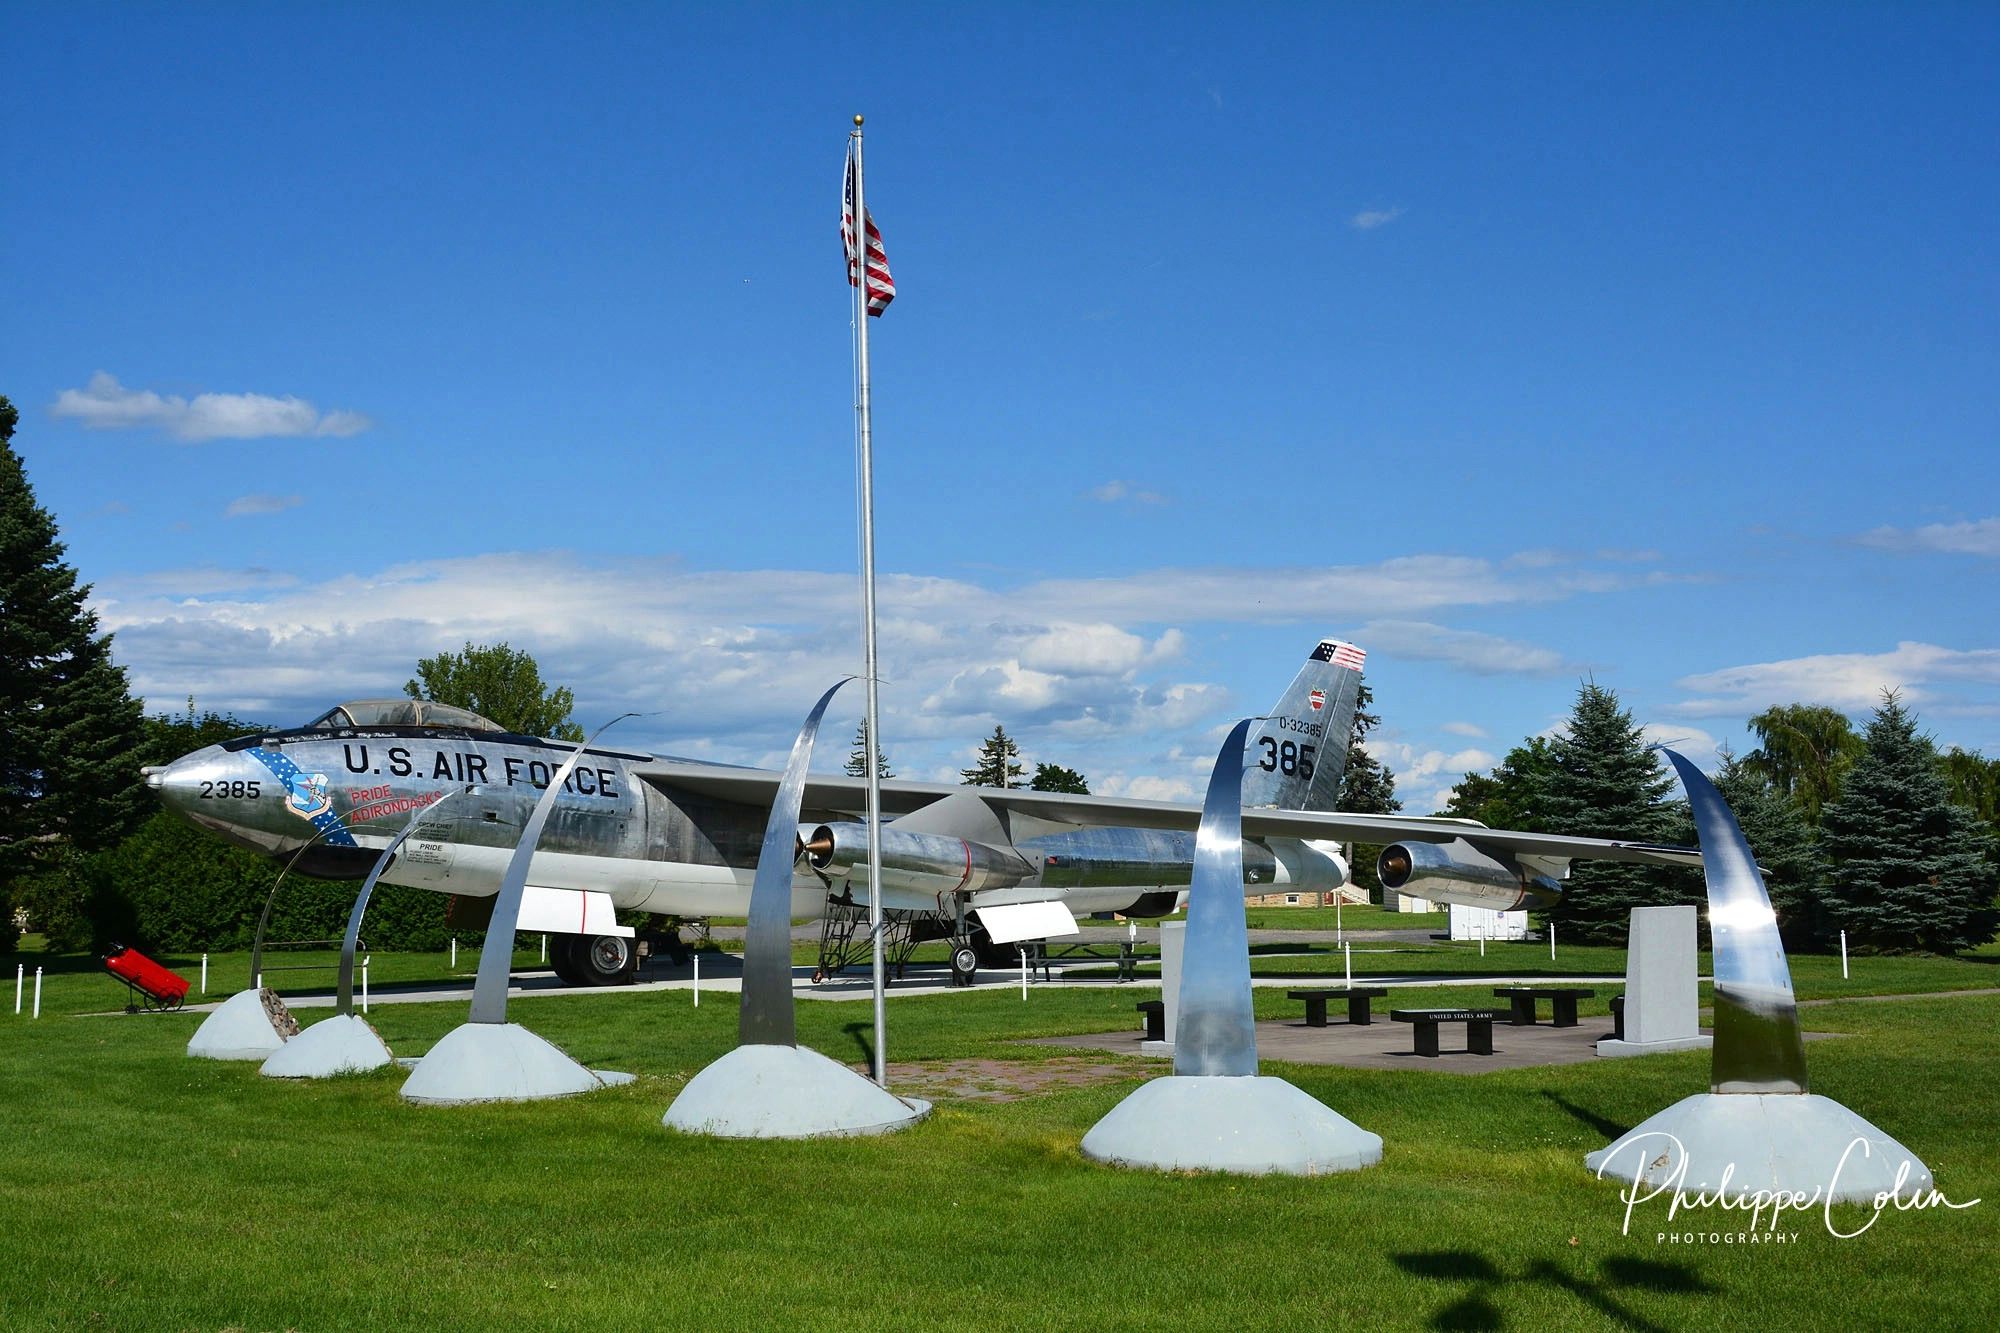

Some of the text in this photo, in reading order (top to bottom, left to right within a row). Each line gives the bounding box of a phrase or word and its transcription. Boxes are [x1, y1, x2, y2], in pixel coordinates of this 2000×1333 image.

[343, 744, 423, 778] U.S.
[432, 751, 489, 784] AIR
[1258, 736, 1316, 781] 385
[199, 780, 261, 799] 2385
[351, 784, 392, 805] PRIDE
[351, 790, 443, 824] ADIRONDACKS
[419, 843, 443, 852] PRIDE
